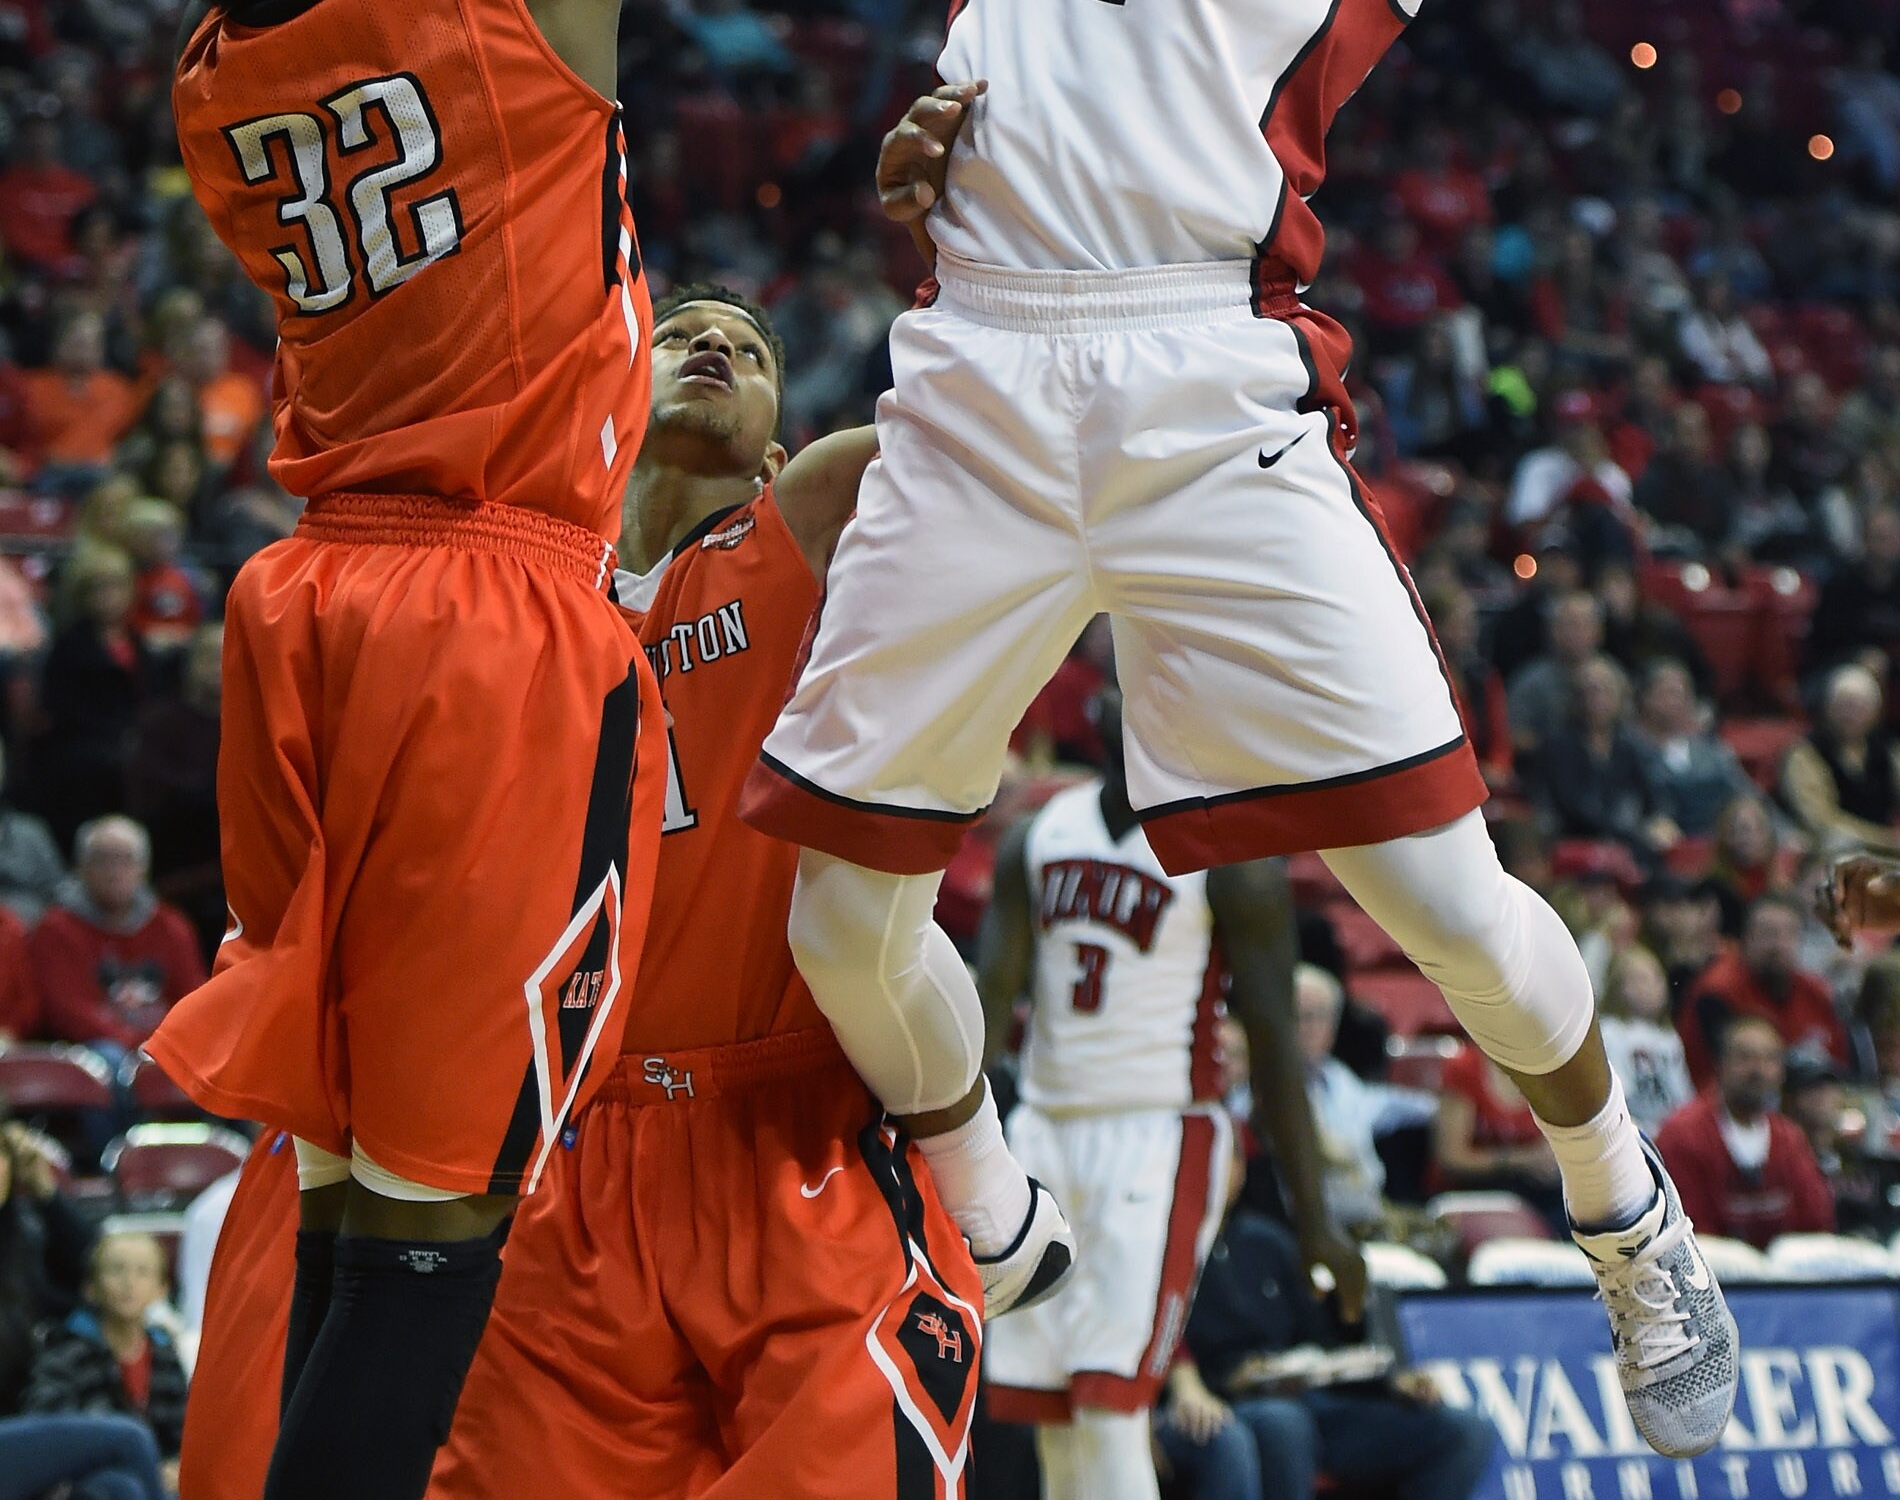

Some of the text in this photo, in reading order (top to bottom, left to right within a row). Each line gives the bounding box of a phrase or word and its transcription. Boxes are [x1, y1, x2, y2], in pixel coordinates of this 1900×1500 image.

[219, 71, 466, 318] 32
[1041, 857, 1176, 956] UNLV
[1073, 941, 1110, 1014] 3
